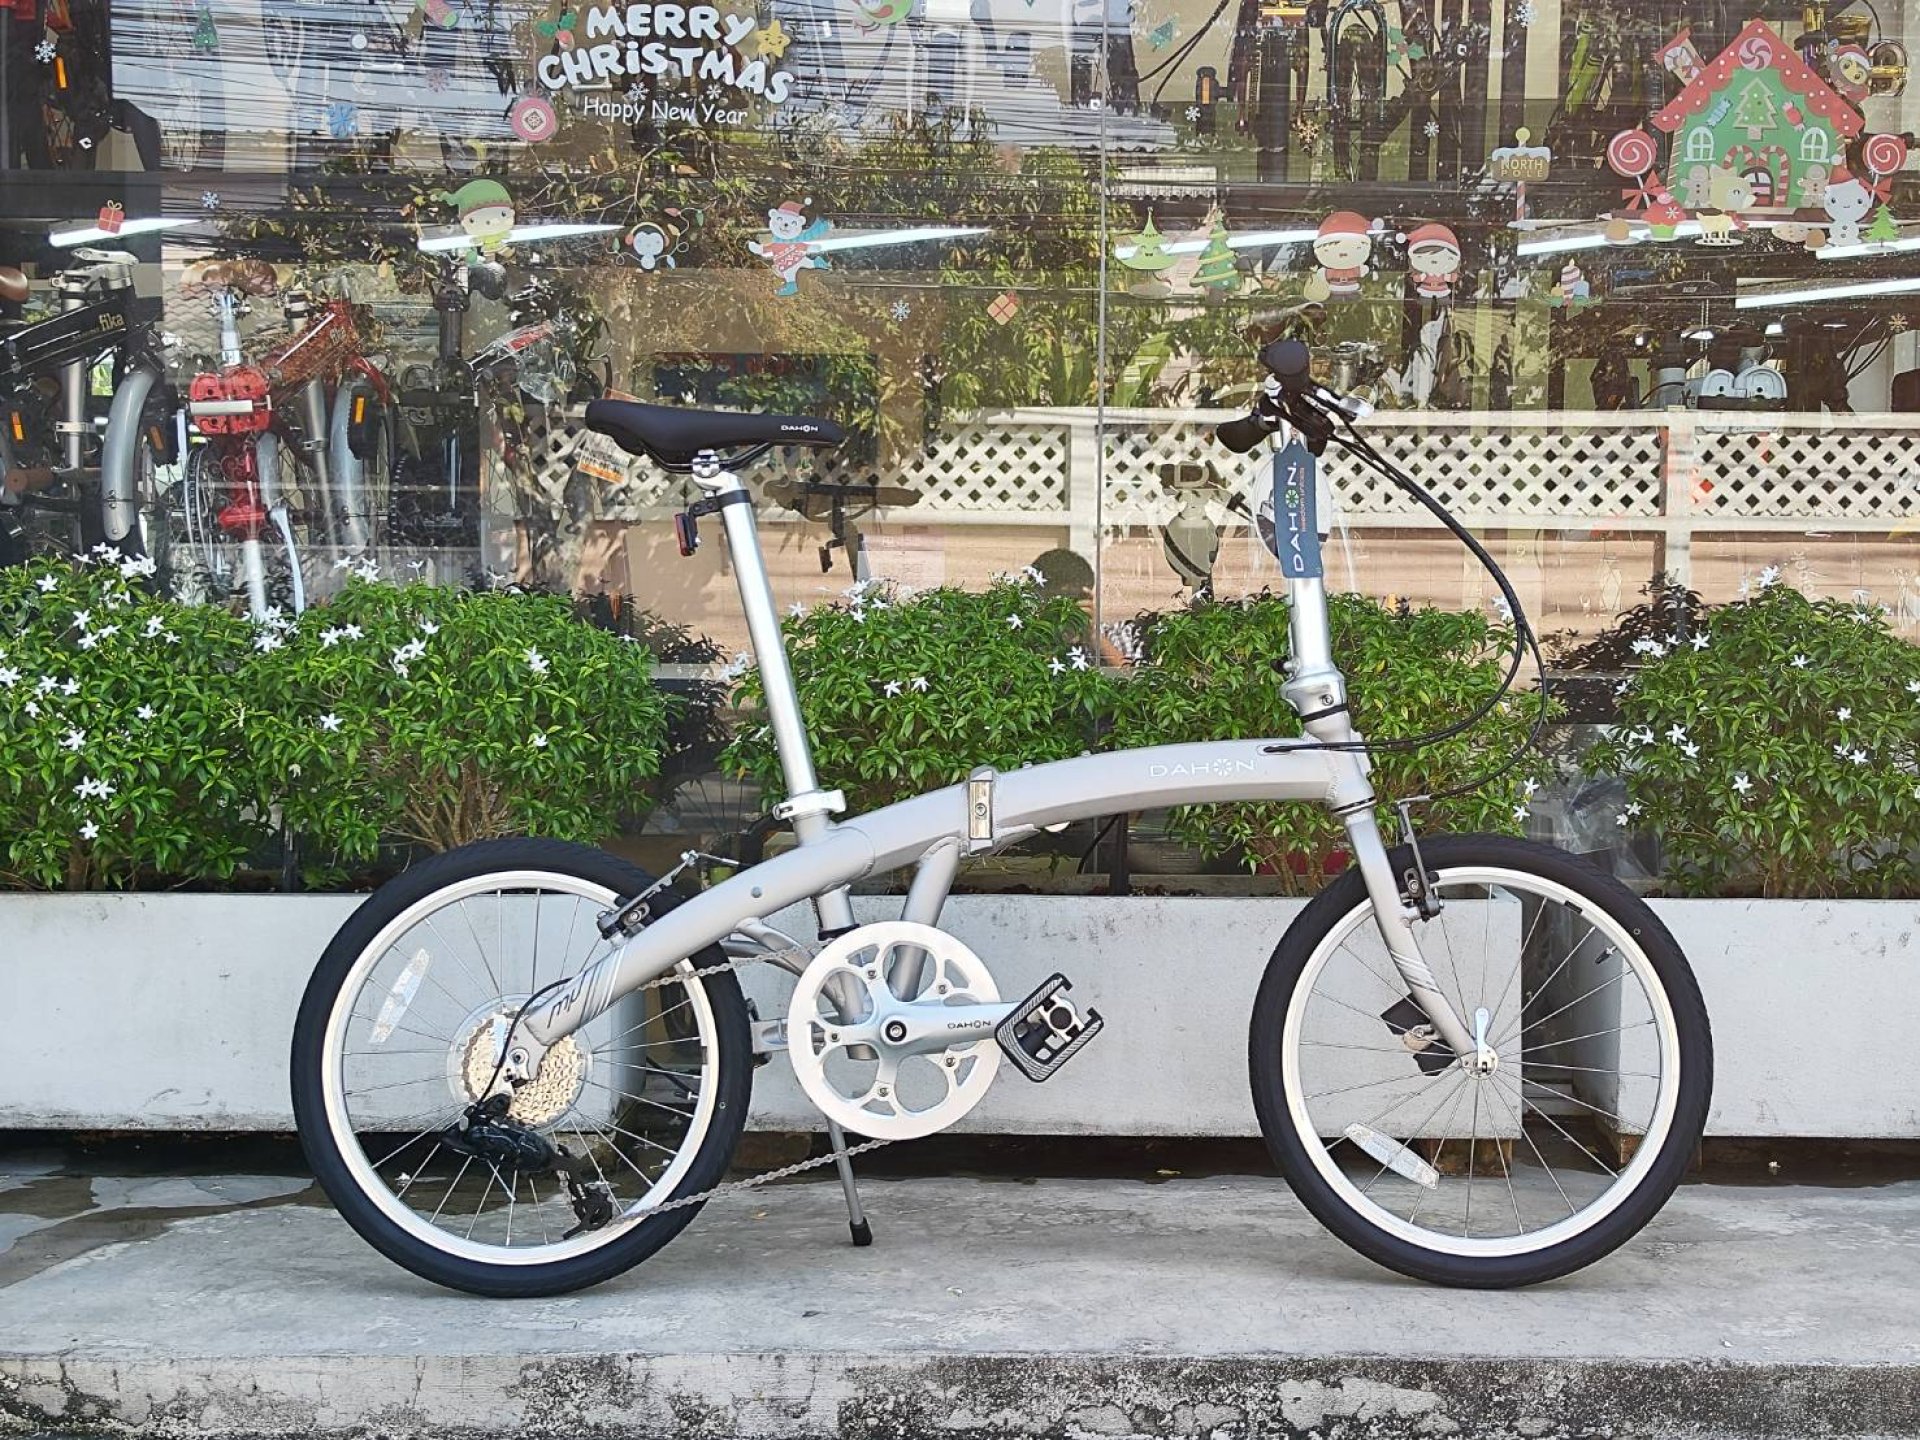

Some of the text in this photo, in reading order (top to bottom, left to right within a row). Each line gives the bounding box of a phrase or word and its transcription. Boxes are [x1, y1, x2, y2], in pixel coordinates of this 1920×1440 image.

[586, 3, 755, 46] MERRY
[584, 96, 748, 126] Happy New Year
[1501, 159, 1543, 170] NORTH
[1501, 169, 1544, 178] POLE
[780, 424, 819, 433] DAHON
[1149, 758, 1256, 777] DAHON
[947, 1019, 992, 1030] DAHON
